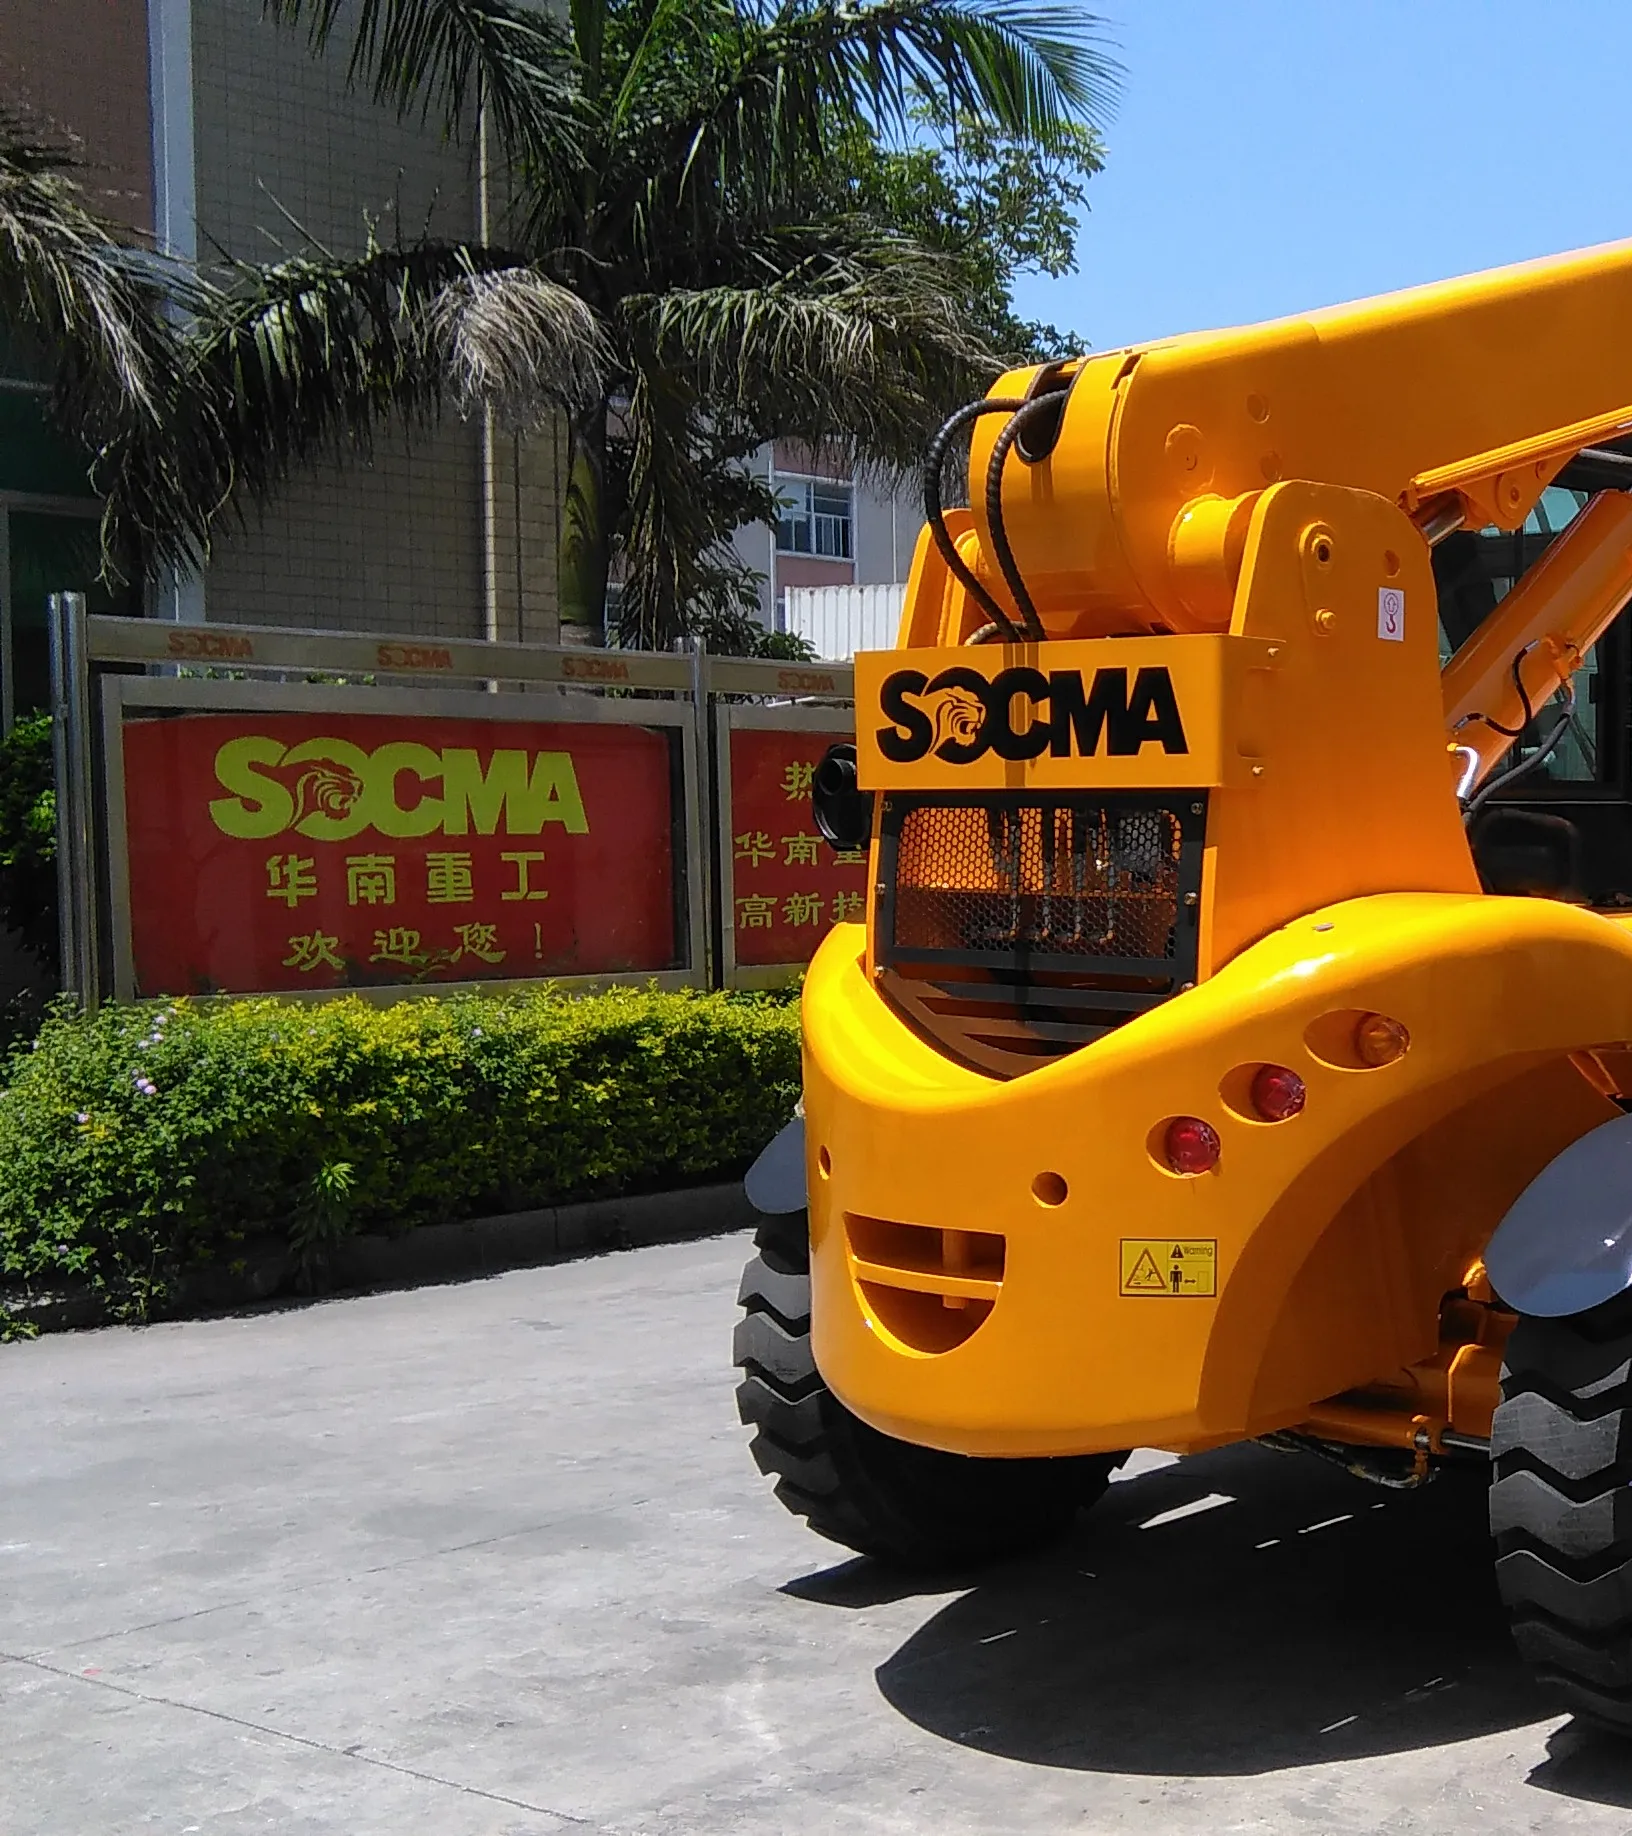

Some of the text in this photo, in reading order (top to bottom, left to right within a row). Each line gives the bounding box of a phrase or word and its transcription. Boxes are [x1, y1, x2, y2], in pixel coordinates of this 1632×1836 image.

[876, 665, 1190, 765] SOCMA
[208, 735, 591, 842] SOCMA
[265, 852, 549, 908] 华南重工
